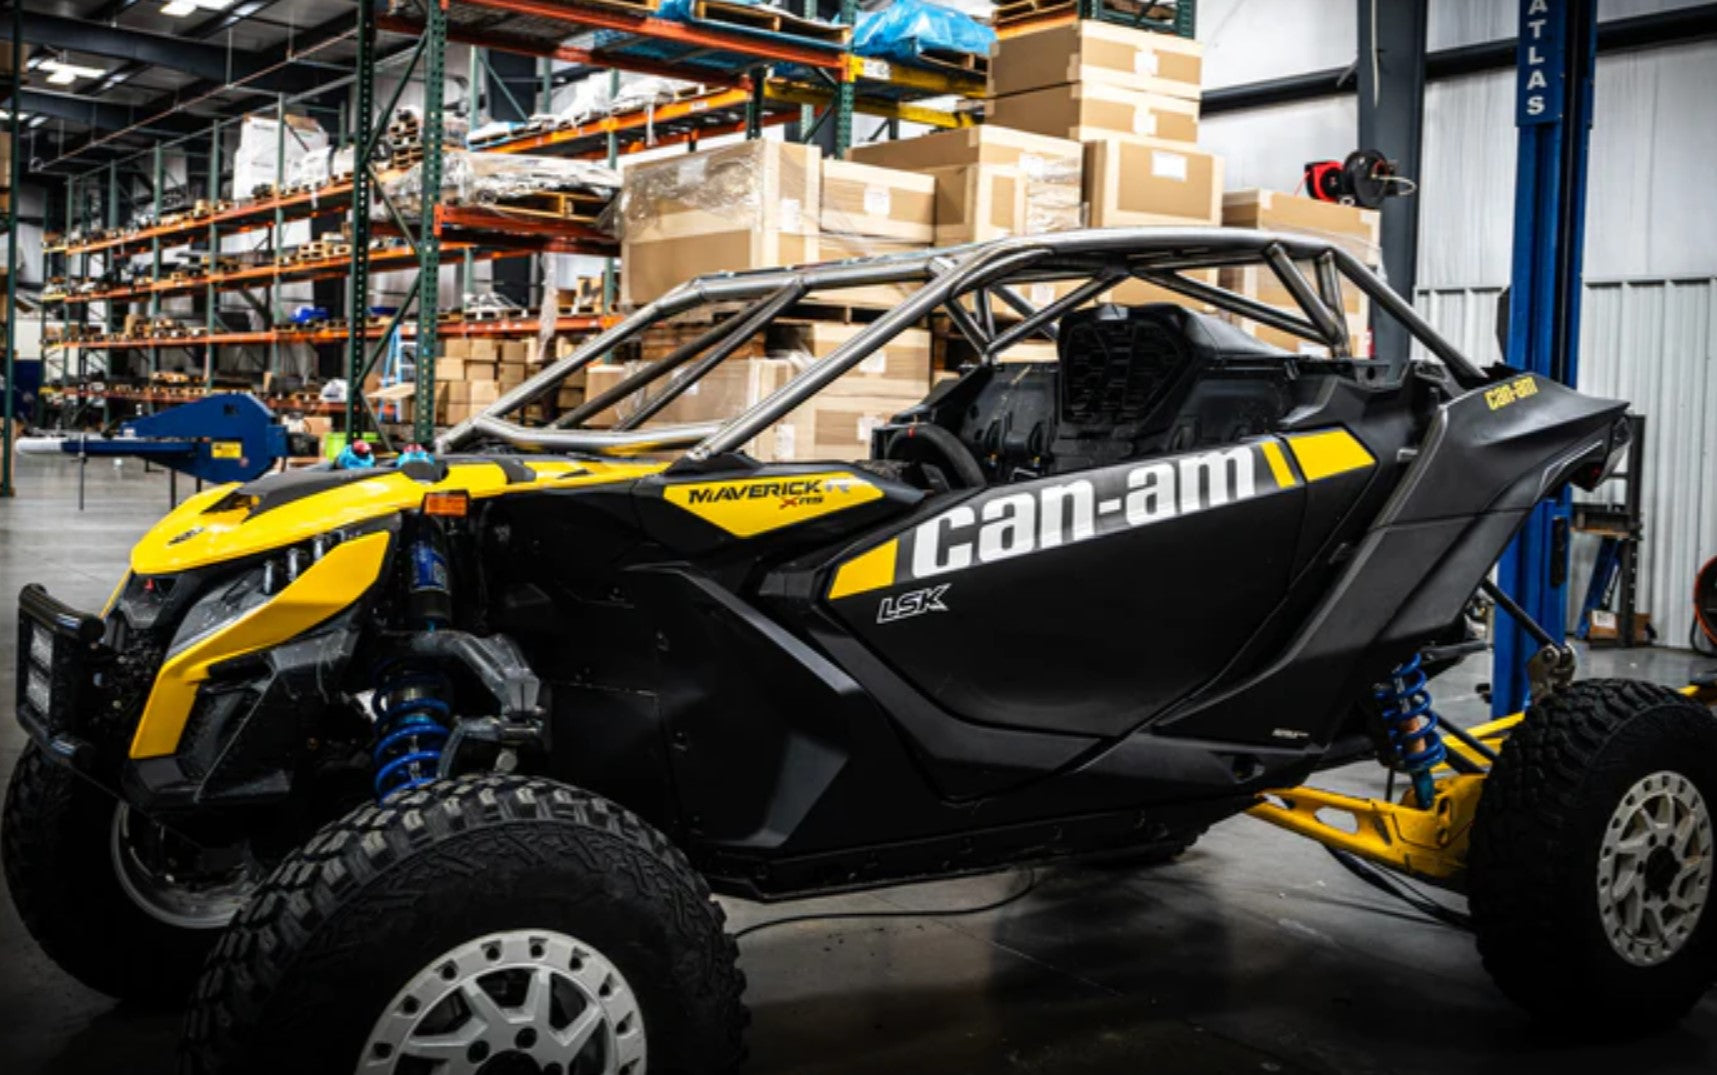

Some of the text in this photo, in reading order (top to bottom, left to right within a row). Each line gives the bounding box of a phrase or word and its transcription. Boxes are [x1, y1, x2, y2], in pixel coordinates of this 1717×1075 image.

[1526, 0, 1548, 115] ATLAS
[688, 480, 822, 504] MAVERICK
[912, 446, 1256, 578] can-am
[876, 583, 952, 624] LSK
